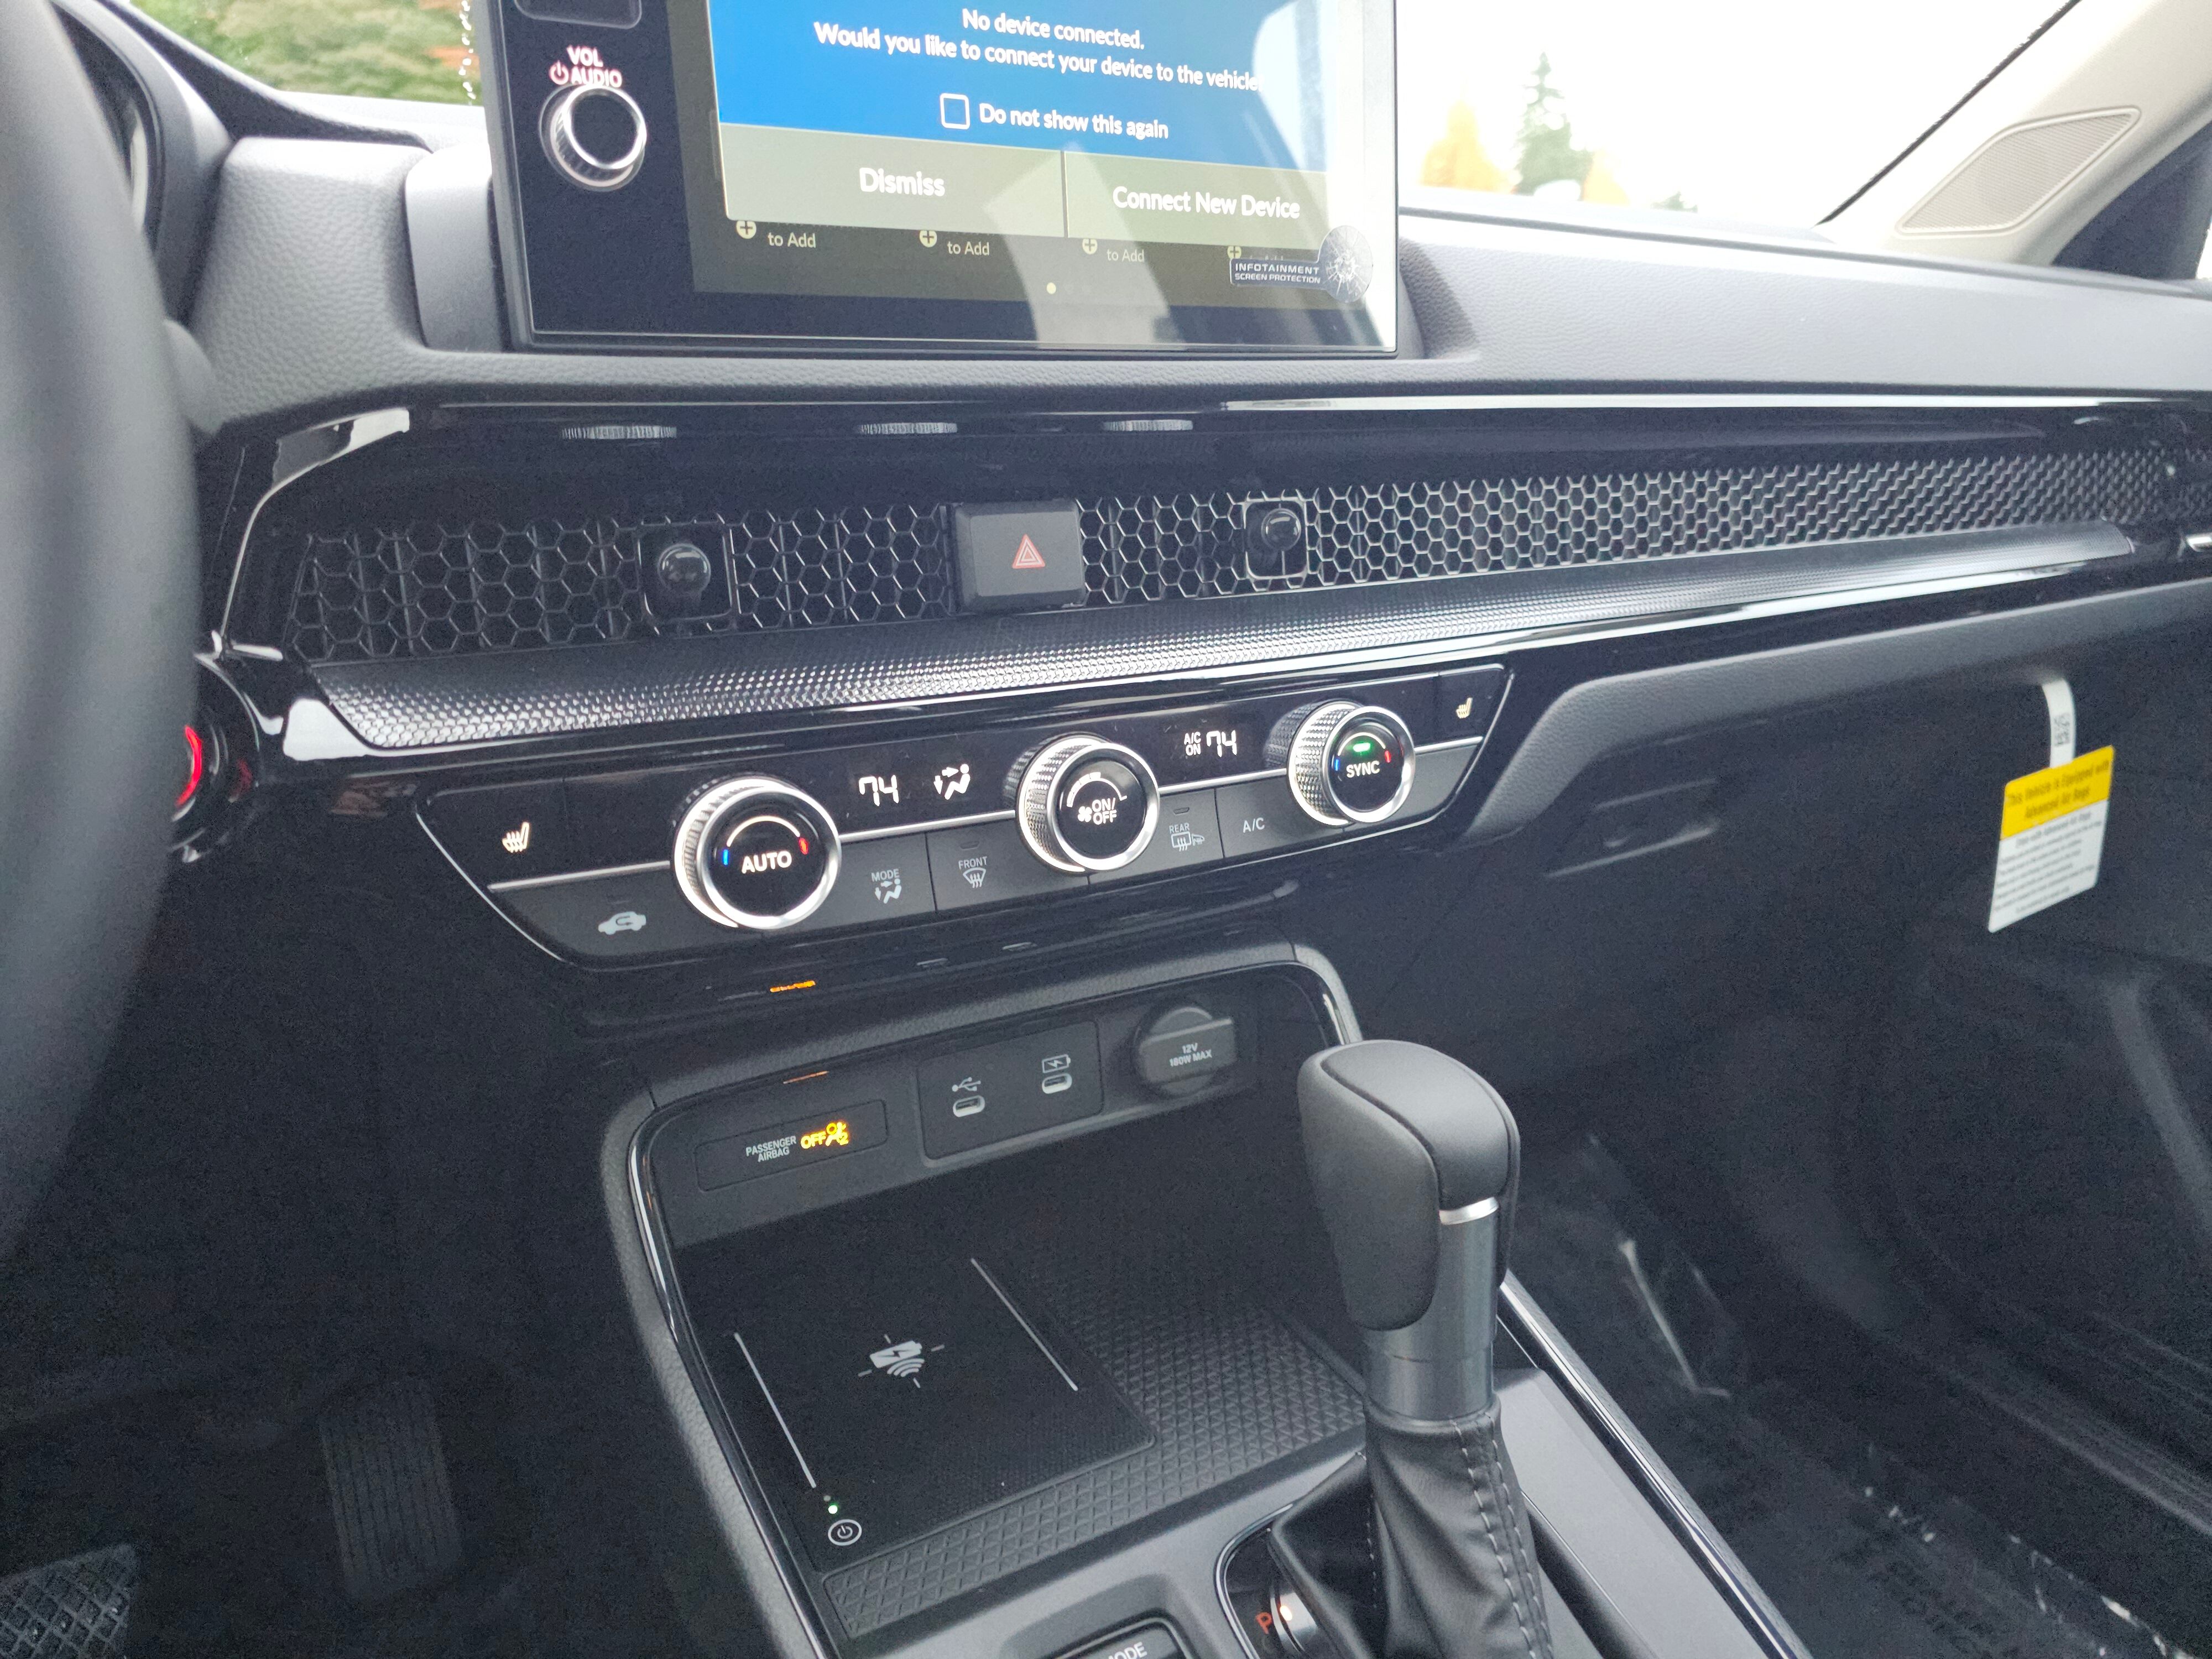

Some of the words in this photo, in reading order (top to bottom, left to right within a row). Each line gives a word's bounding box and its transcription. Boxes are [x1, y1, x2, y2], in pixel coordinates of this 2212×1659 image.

[962, 8, 990, 31] No
[994, 13, 1050, 38] device
[1053, 23, 1145, 50] connected.
[566, 44, 603, 67] VOL
[813, 22, 880, 50] Would
[884, 34, 920, 55] you
[925, 34, 957, 58] like
[960, 40, 980, 60] to
[984, 46, 1055, 69] connect
[1058, 55, 1098, 74] your
[1101, 56, 1152, 80] device
[1156, 62, 1173, 81] to
[1177, 65, 1203, 85] the
[571, 66, 622, 88] AUDIO
[979, 103, 1006, 124] Do
[1010, 109, 1040, 127] not
[1044, 109, 1089, 132] show
[1092, 114, 1123, 135] this
[1126, 119, 1168, 140] again
[859, 167, 945, 196] Dismiss
[1113, 186, 1191, 212] Connect
[1196, 191, 1237, 215] New
[1241, 194, 1300, 219] Device
[768, 233, 784, 247] to
[787, 232, 816, 248] Add
[947, 241, 961, 255] to
[964, 241, 990, 256] Add
[1107, 249, 1119, 262] to
[1121, 249, 1145, 263] Add
[1235, 263, 1320, 275] INFOTAINMENT
[1269, 274, 1321, 284] PROTECTION
[1184, 732, 1201, 745] A/C
[1206, 730, 1237, 757] 74
[1186, 744, 1201, 756] ON
[1346, 760, 1380, 778] SYNC
[859, 774, 899, 806] 74
[1092, 798, 1116, 812] ON/
[1093, 810, 1117, 825] OFF
[1243, 817, 1265, 833] A/C
[1169, 822, 1190, 833] REAR
[742, 850, 792, 874] AUTO
[958, 855, 988, 870] FRONT
[871, 868, 900, 882] MODE
[1182, 1042, 1198, 1054] 12V
[1169, 1054, 1192, 1067] 180W
[1192, 1049, 1213, 1061] MAX
[745, 1135, 797, 1157] PASSENGER
[801, 1131, 827, 1149] OFF
[758, 1146, 790, 1162] AIRBAG
[1256, 1611, 1272, 1635] P
[1108, 1641, 1147, 1659] ODE
